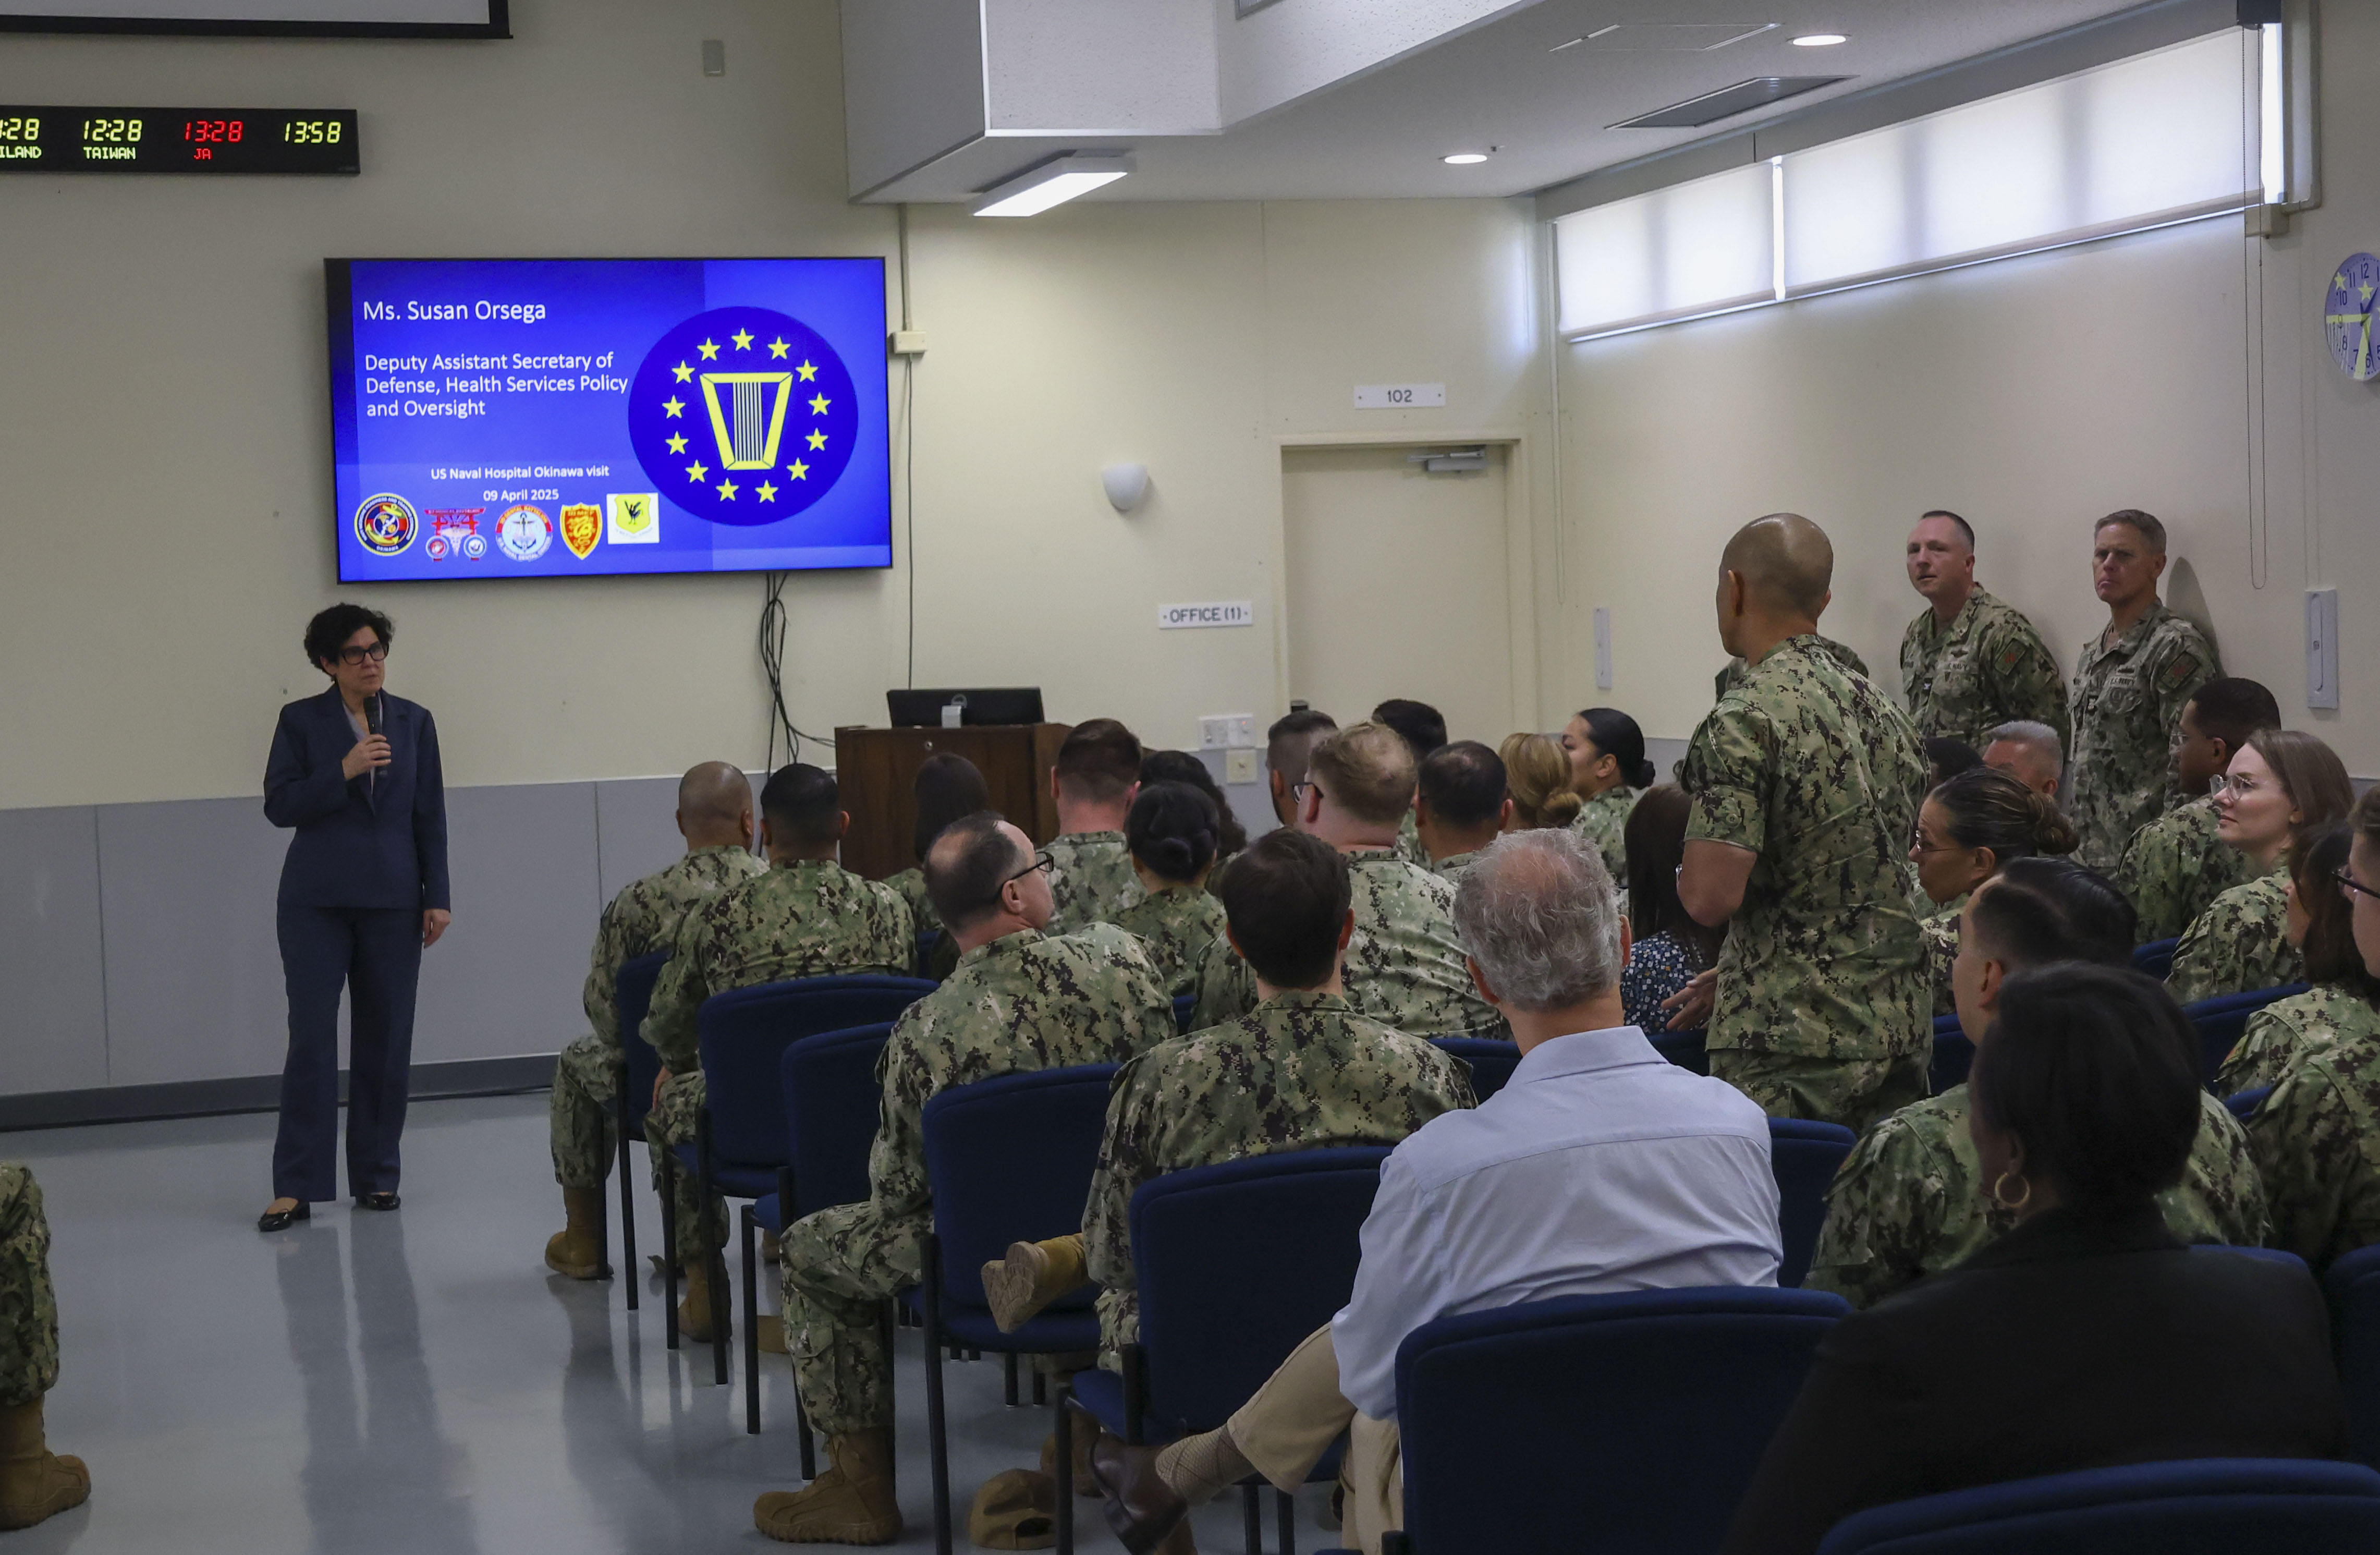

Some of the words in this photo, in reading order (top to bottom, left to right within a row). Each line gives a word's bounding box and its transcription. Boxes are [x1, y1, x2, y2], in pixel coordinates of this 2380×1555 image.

[84, 119, 142, 141] 12:28
[185, 120, 243, 142] 13:28
[285, 122, 341, 143] 13:58
[83, 147, 136, 160] TAIWAN
[193, 148, 212, 160] JA
[2349, 271, 2355, 287] 11
[2361, 263, 2370, 280] 12
[2339, 290, 2347, 306] 10
[364, 301, 400, 320] Ms.
[408, 301, 468, 320] Susan
[475, 300, 545, 323] Orsega
[2342, 335, 2348, 350] 8
[365, 355, 428, 374] Deputy
[432, 354, 508, 370] Assistant
[512, 353, 592, 372] Secretary
[596, 351, 614, 368] of
[2353, 349, 2359, 365] 7
[2365, 353, 2371, 368] 6
[367, 376, 440, 395] Defense,
[446, 375, 502, 393] Health
[507, 375, 575, 392] Services
[580, 374, 628, 394] Policy
[1387, 390, 1412, 403] 102
[367, 399, 398, 417] and
[404, 398, 486, 419] Oversight
[431, 468, 447, 480] US
[449, 467, 482, 480] Naval
[484, 466, 531, 481] Hospital
[534, 466, 583, 478] Okinawa
[585, 465, 609, 477] visit
[483, 490, 498, 502] 09
[501, 489, 529, 503] April
[531, 489, 559, 501] 2025
[1170, 607, 1220, 623] OFFICE
[1225, 606, 1242, 621] (1)
